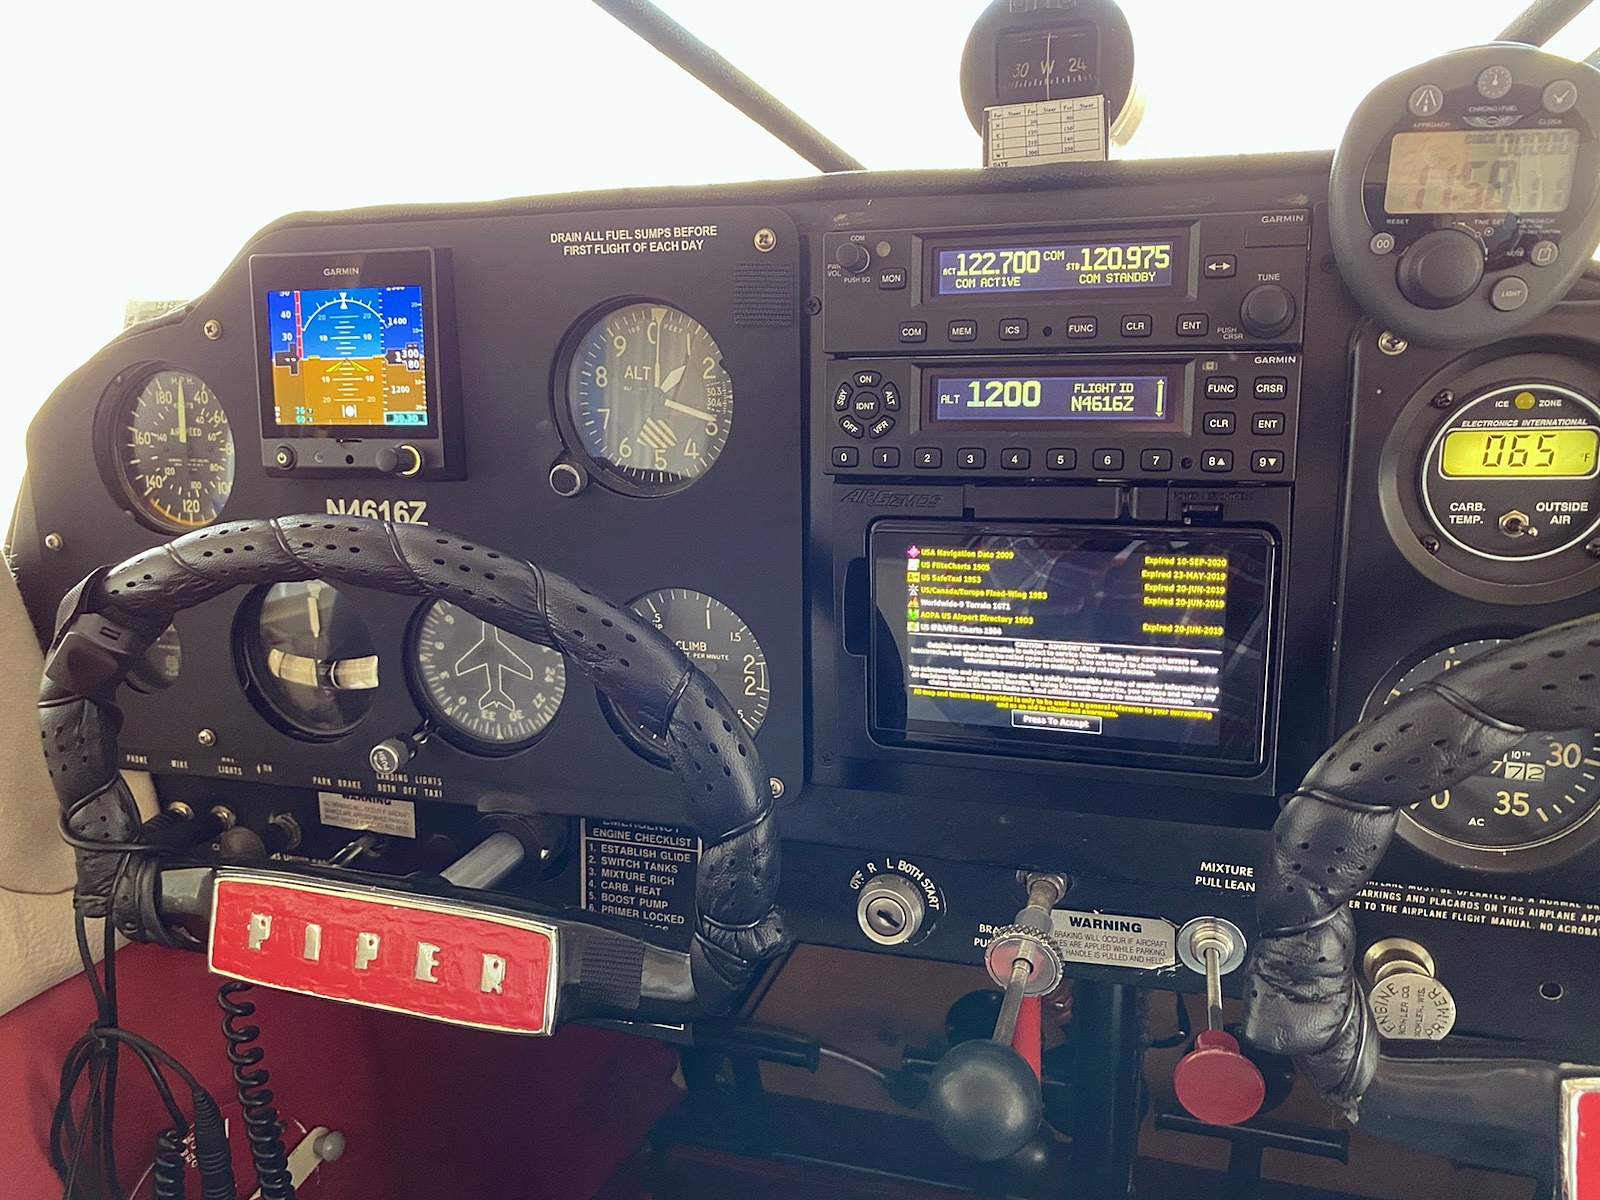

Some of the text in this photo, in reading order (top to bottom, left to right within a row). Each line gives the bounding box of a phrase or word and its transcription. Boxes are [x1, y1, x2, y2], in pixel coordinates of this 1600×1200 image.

[1013, 62, 1030, 78] 30
[1041, 59, 1055, 74] W
[1068, 57, 1088, 72] 24
[1261, 215, 1304, 223] GARMIN
[550, 225, 717, 243] DRAIN ALL FUEL SUMPS BEFORE
[564, 239, 704, 255] FIRST FLIGHT OF EACH DAY
[942, 250, 1041, 275] ACT 122.700
[1043, 250, 1065, 261] COM
[1080, 244, 1171, 271] 120.975
[323, 267, 359, 276] GARMIN
[881, 274, 901, 282] MON
[1078, 271, 1156, 284] COM STANDBY
[1257, 273, 1280, 281] TUNE
[955, 276, 1021, 288] COM ACTIVE
[1501, 289, 1522, 297] LIGHT
[280, 311, 291, 319] 40
[387, 317, 407, 326] 1400
[902, 328, 922, 336] COM
[951, 327, 972, 335] MEM
[1005, 326, 1020, 334] ICS
[1068, 324, 1094, 332] FUNC
[1126, 322, 1145, 330] CLR
[1182, 321, 1201, 330] ENT
[282, 333, 293, 341] 30
[613, 335, 627, 357] 9
[1254, 356, 1296, 364] GARMIN
[624, 366, 651, 381] ALT
[703, 357, 716, 380] 2
[596, 366, 607, 387] 8
[859, 375, 872, 383] ON
[391, 386, 410, 394] 1200
[940, 380, 1041, 407] ALT 1200
[1074, 382, 1134, 393] FLIGHT ID
[1207, 384, 1234, 393] FUNC
[1256, 384, 1283, 393] CRSR
[155, 391, 172, 404] 180
[194, 391, 208, 404] 40
[837, 389, 848, 406] SBY
[885, 391, 895, 406] ALT
[1070, 396, 1134, 412] N4616Z
[1539, 399, 1562, 407] ZONE
[856, 402, 875, 410] IDNT
[597, 408, 611, 430] 7
[842, 419, 858, 434] OFF
[1209, 419, 1229, 428] CLR
[1258, 420, 1277, 428] ENT
[1461, 418, 1588, 428] ELECTRONICS INTERNATIONAL
[873, 420, 889, 434] VFR
[135, 431, 151, 445] 160
[619, 437, 632, 458] 6
[684, 438, 699, 459] 4
[1482, 434, 1557, 467] 065
[654, 450, 667, 470] 5
[145, 475, 163, 489] 140
[183, 499, 200, 513] 120
[326, 499, 429, 525] N4616Z
[1450, 502, 1486, 512] CARB.
[1536, 502, 1589, 512] OUTSIDE
[1449, 515, 1484, 525] TEMP.
[1550, 515, 1571, 525] AIR
[921, 548, 1014, 559] USA Navigation Data 2009
[1144, 556, 1228, 567] Expired 10-SEP-2020
[1141, 570, 1226, 581] Expired 23-MAY-2019
[743, 654, 755, 675] 2
[744, 676, 757, 696] 2
[1023, 715, 1090, 729] Press To Accept
[1546, 742, 1582, 768] 30
[312, 776, 362, 789] PARK BRAKE
[414, 775, 443, 786] LIGHTS
[377, 783, 443, 798] BOTH OFF TAXI
[1493, 791, 1530, 817] 35
[1468, 817, 1485, 826] AC
[593, 828, 691, 847] ENGINE CHECKLIST
[601, 844, 691, 863] ESTABLISH GLIDE
[601, 856, 679, 874] SWITCH TANKS
[1200, 861, 1254, 878] MIXTURE
[601, 868, 675, 886] MIXTURE RICH
[867, 858, 940, 911] R L BOTH START
[1195, 875, 1256, 892] PULL LEAN
[601, 880, 661, 896] CARB. HEAT
[601, 892, 669, 909] BOOST PUMP
[1405, 894, 1577, 921] AND PLACARDS ON THIS AIRPLANE
[601, 904, 685, 925] PRIMER LOCKED
[1364, 901, 1377, 911] TO
[1380, 903, 1398, 913] THE
[1402, 906, 1448, 919] AIRPLANE
[1452, 912, 1486, 924] FLIGHT
[1540, 922, 1554, 931] NO
[1069, 916, 1142, 934] WARNING
[1054, 930, 1168, 947] BRAKING WILL OCCUR AIRCRAFT
[247, 911, 506, 994] PIPER
[1069, 939, 1166, 957] ARE APPLIED WHILE PARKING
[1066, 949, 1164, 965] HANDLE PULLED AND HELD
[1374, 982, 1399, 1033] ENGINE
[1425, 987, 1450, 1039] PRIMER
